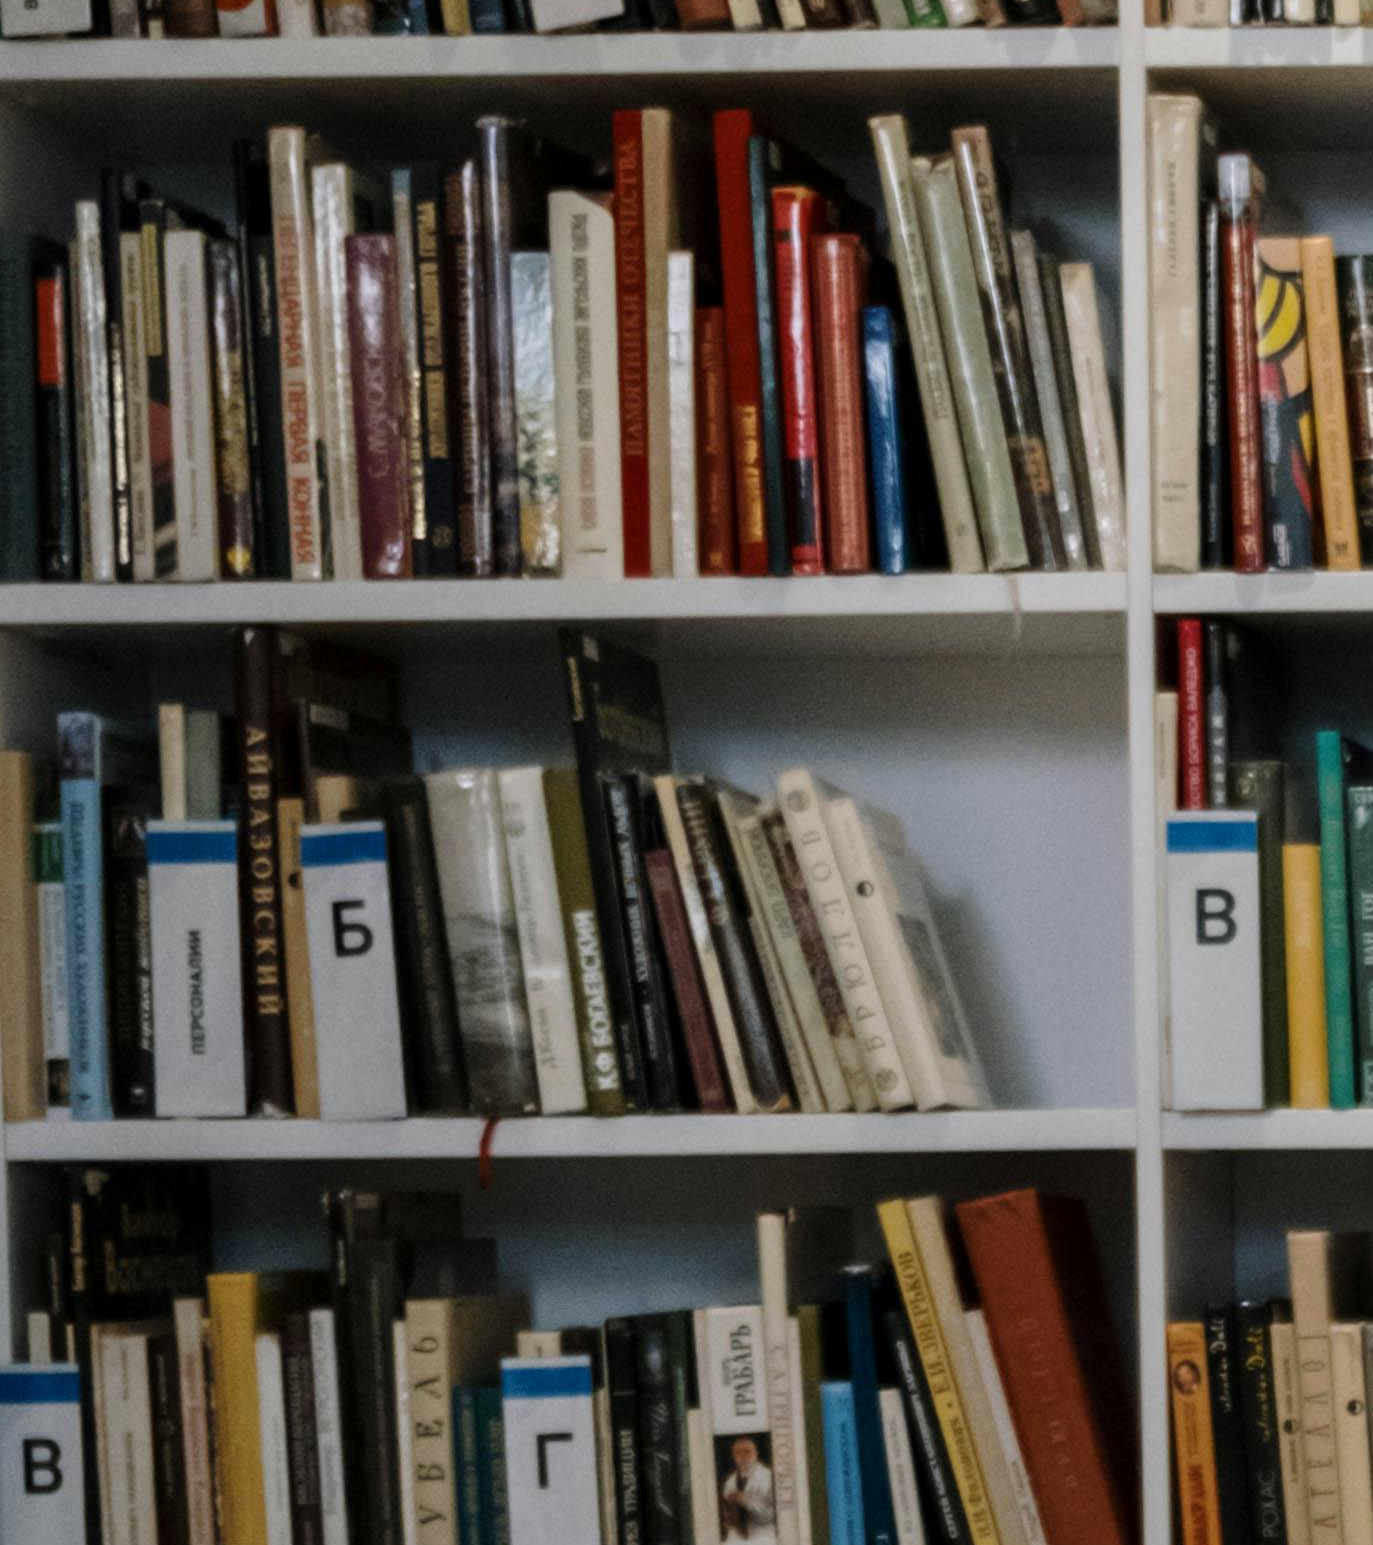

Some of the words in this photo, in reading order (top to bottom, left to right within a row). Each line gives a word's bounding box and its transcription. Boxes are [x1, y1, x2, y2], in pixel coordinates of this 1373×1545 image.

[618, 138, 641, 285] ОТЕЧЕСТВА
[619, 290, 643, 455] ПАМЯТНИКИ
[246, 725, 287, 1018] АЙВАЗОВСКИЙ
[1195, 889, 1235, 944] В
[332, 898, 374, 958] Б
[191, 927, 207, 1055] ПЕРСОНАЛИИ
[729, 1323, 760, 1421] ГРАБАРЬ
[22, 1437, 65, 1496] В
[533, 1432, 574, 1491] Г
